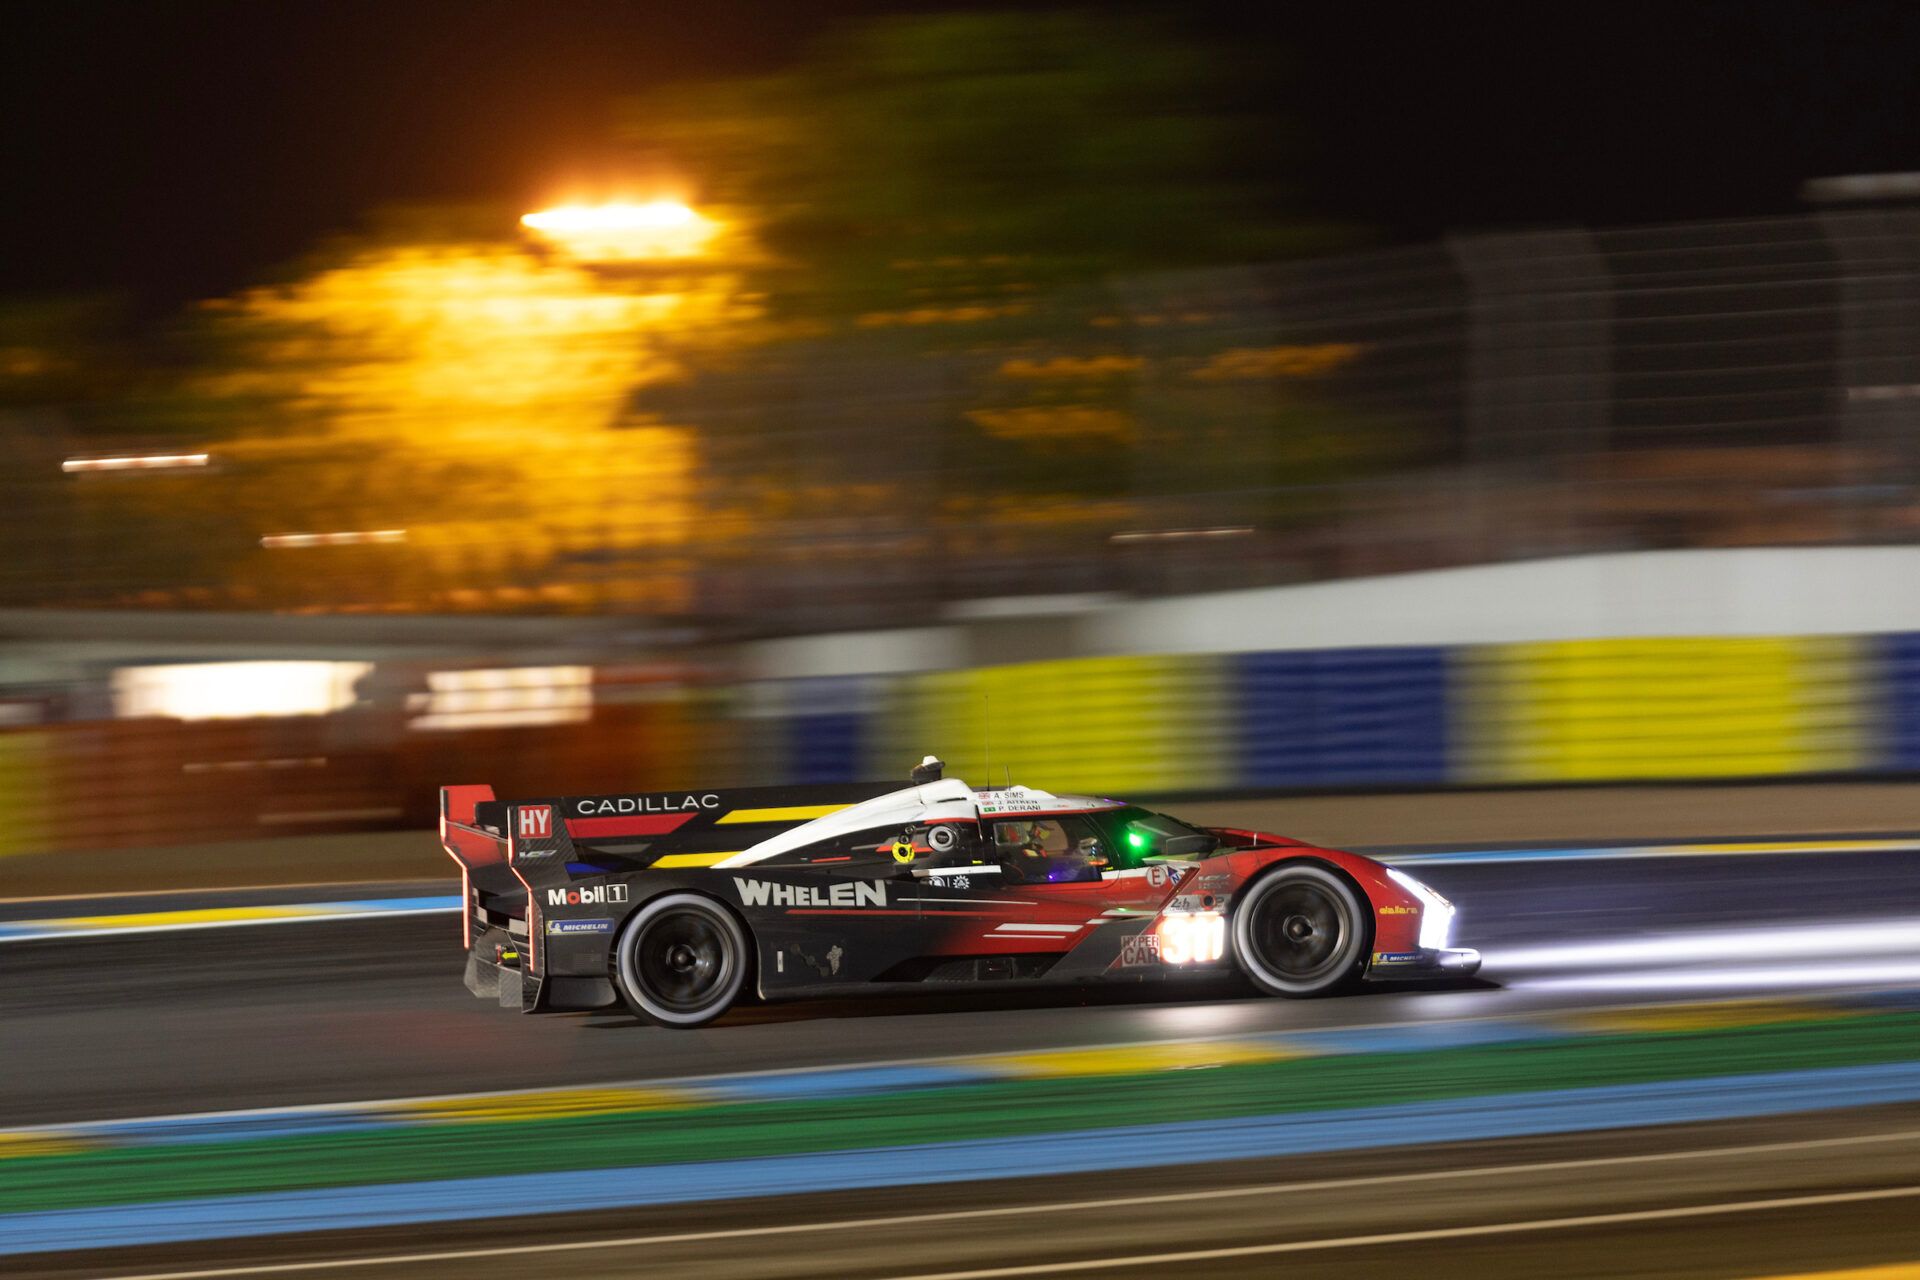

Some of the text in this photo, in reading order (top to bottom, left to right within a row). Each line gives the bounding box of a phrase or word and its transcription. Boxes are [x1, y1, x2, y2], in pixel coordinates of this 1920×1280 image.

[577, 794, 720, 814] CADILLAC
[1004, 791, 1024, 799] SIMS
[520, 809, 549, 835] HY
[1151, 868, 1161, 885] E
[548, 885, 605, 906] Mobil
[733, 876, 888, 906] WHELEN
[563, 923, 608, 931] MICHELIN
[1123, 935, 1159, 948] HYPER
[1123, 947, 1159, 965] CAR
